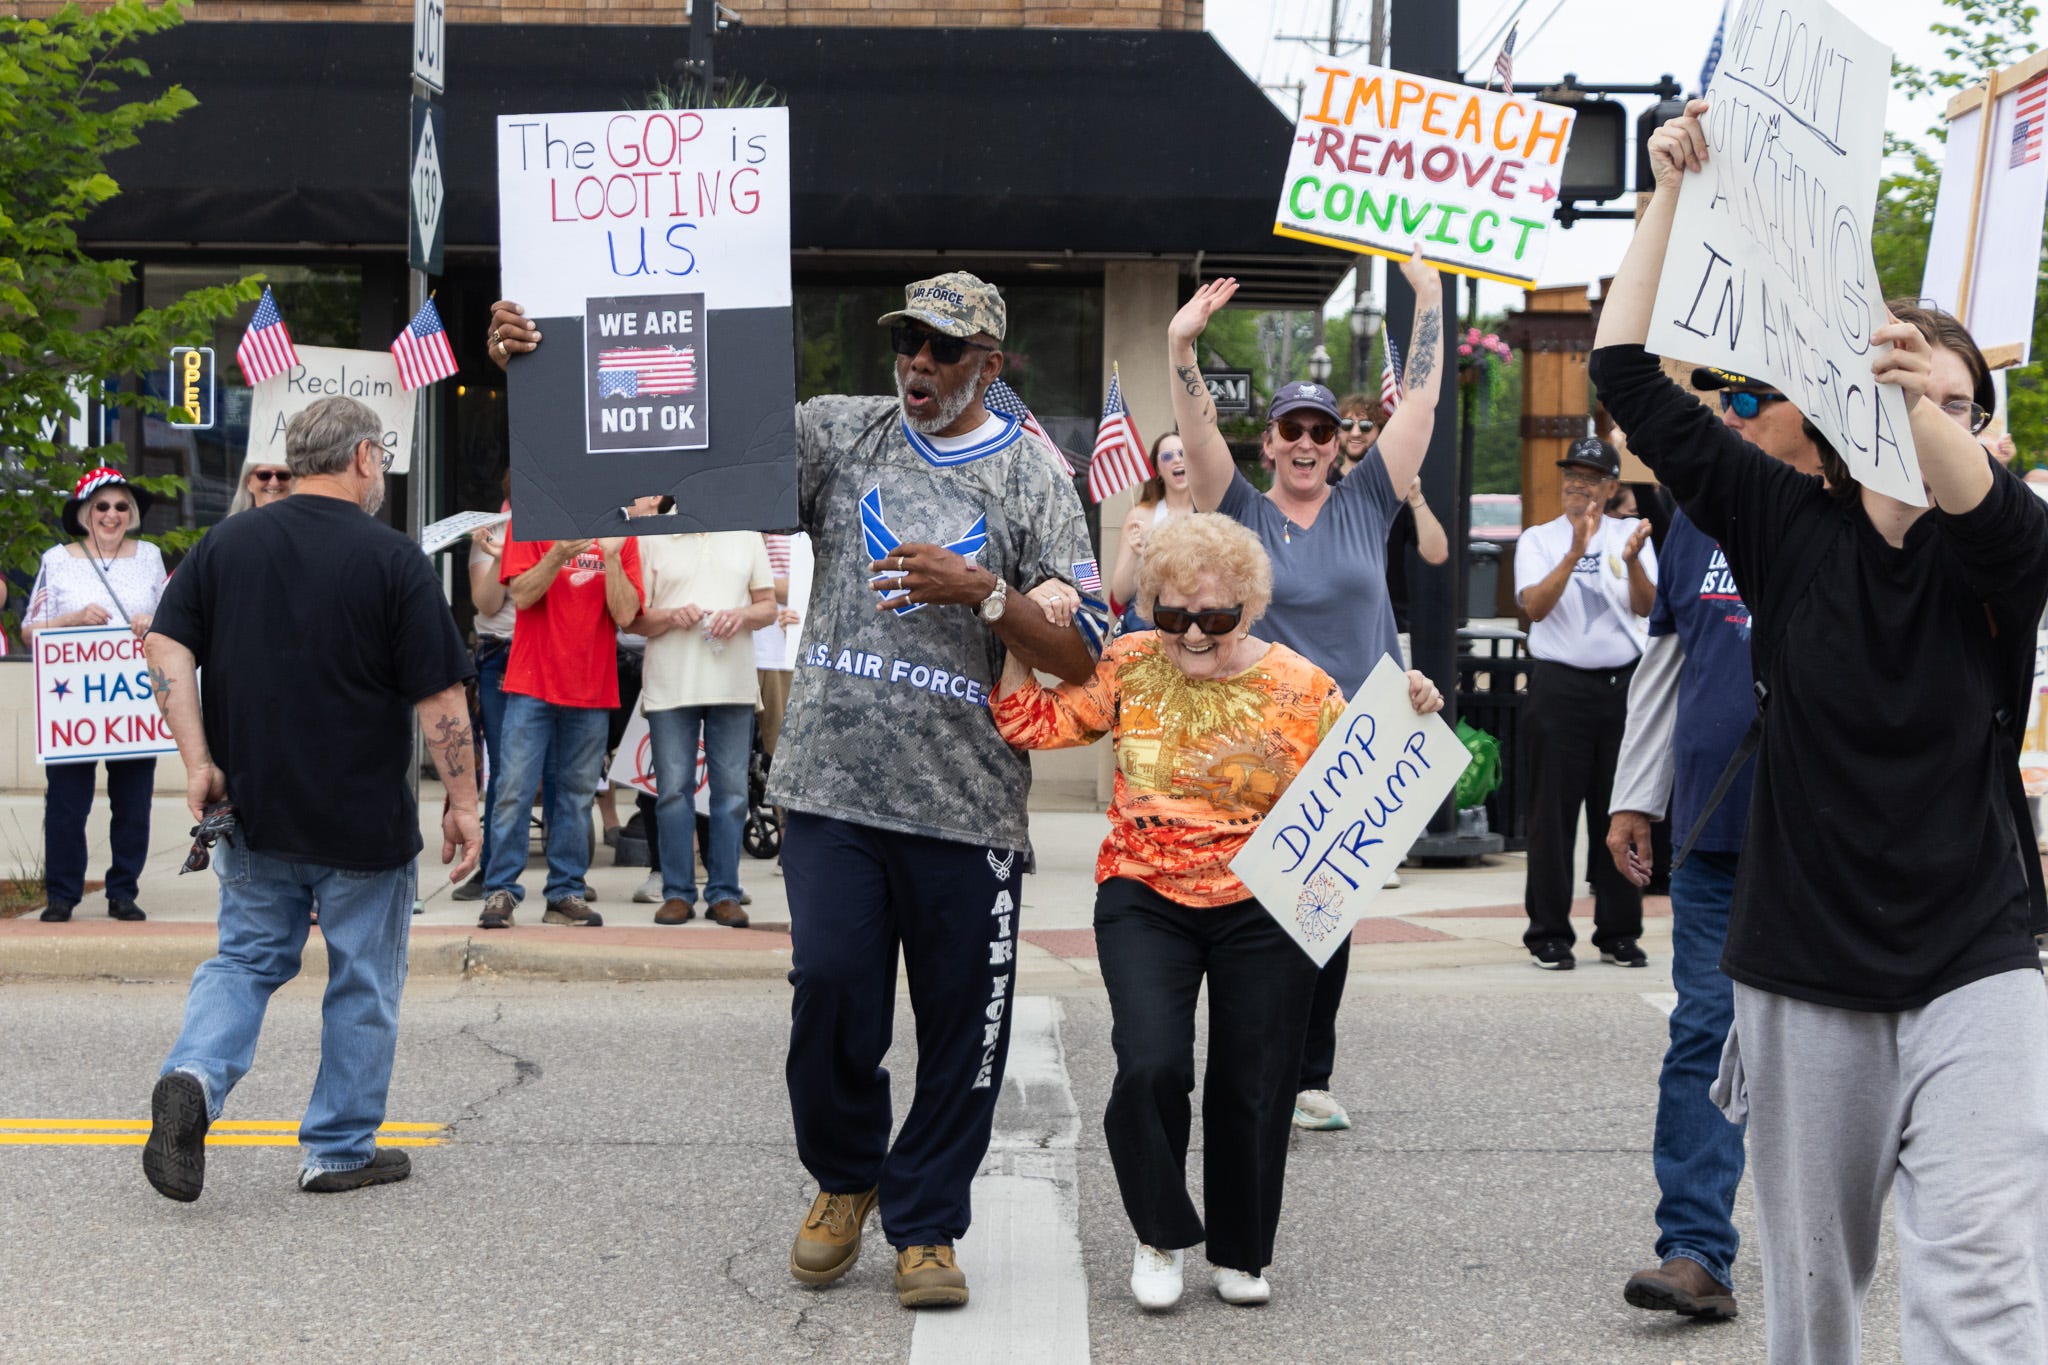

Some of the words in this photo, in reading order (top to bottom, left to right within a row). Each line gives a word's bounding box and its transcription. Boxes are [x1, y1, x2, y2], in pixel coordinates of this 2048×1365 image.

[419, 0, 442, 71] JCT
[1732, 0, 1764, 73] WE
[1764, 9, 1854, 143] DON'T
[509, 123, 596, 171] The
[606, 113, 704, 168] GOP
[732, 126, 767, 164] is
[1303, 66, 1570, 165] IMPEACH
[1313, 127, 1525, 199] REMOVE
[420, 166, 437, 227] 139
[551, 168, 761, 222] LOOTING
[1289, 175, 1546, 260] CONVICT
[608, 223, 699, 277] U.S.
[599, 312, 644, 337] WE
[646, 310, 693, 334] ARE
[926, 287, 964, 306] FORCE
[1673, 241, 1746, 352] IN
[288, 363, 393, 397] Reclaim
[601, 406, 653, 433] NOT
[660, 405, 695, 431] OK
[44, 640, 146, 665] DEMOCR
[806, 643, 832, 668] U.S.
[835, 649, 884, 681] AIR
[890, 659, 982, 705] FORCE
[84, 671, 154, 704] HAS
[51, 718, 96, 748] NO
[1273, 713, 1376, 873] DUMP
[1303, 731, 1427, 891] TRUMP
[990, 889, 1015, 965] AIR
[971, 974, 1010, 1091] FORCE
